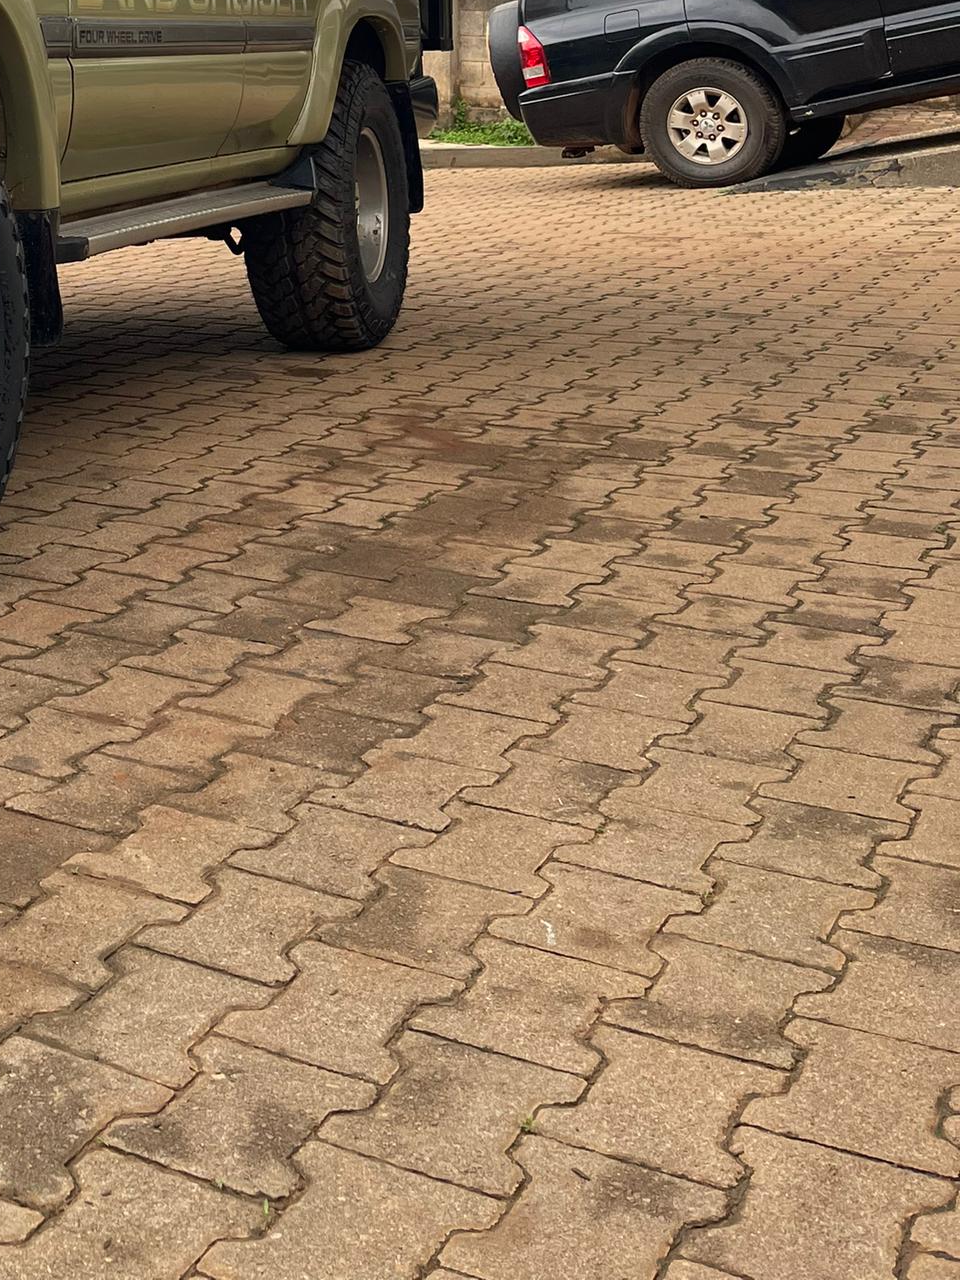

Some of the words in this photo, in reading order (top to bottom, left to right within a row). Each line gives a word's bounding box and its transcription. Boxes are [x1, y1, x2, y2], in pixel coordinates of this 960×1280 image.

[79, 30, 104, 44] FOUR
[106, 30, 137, 44] WHEEL
[138, 30, 162, 44] DRIVE
